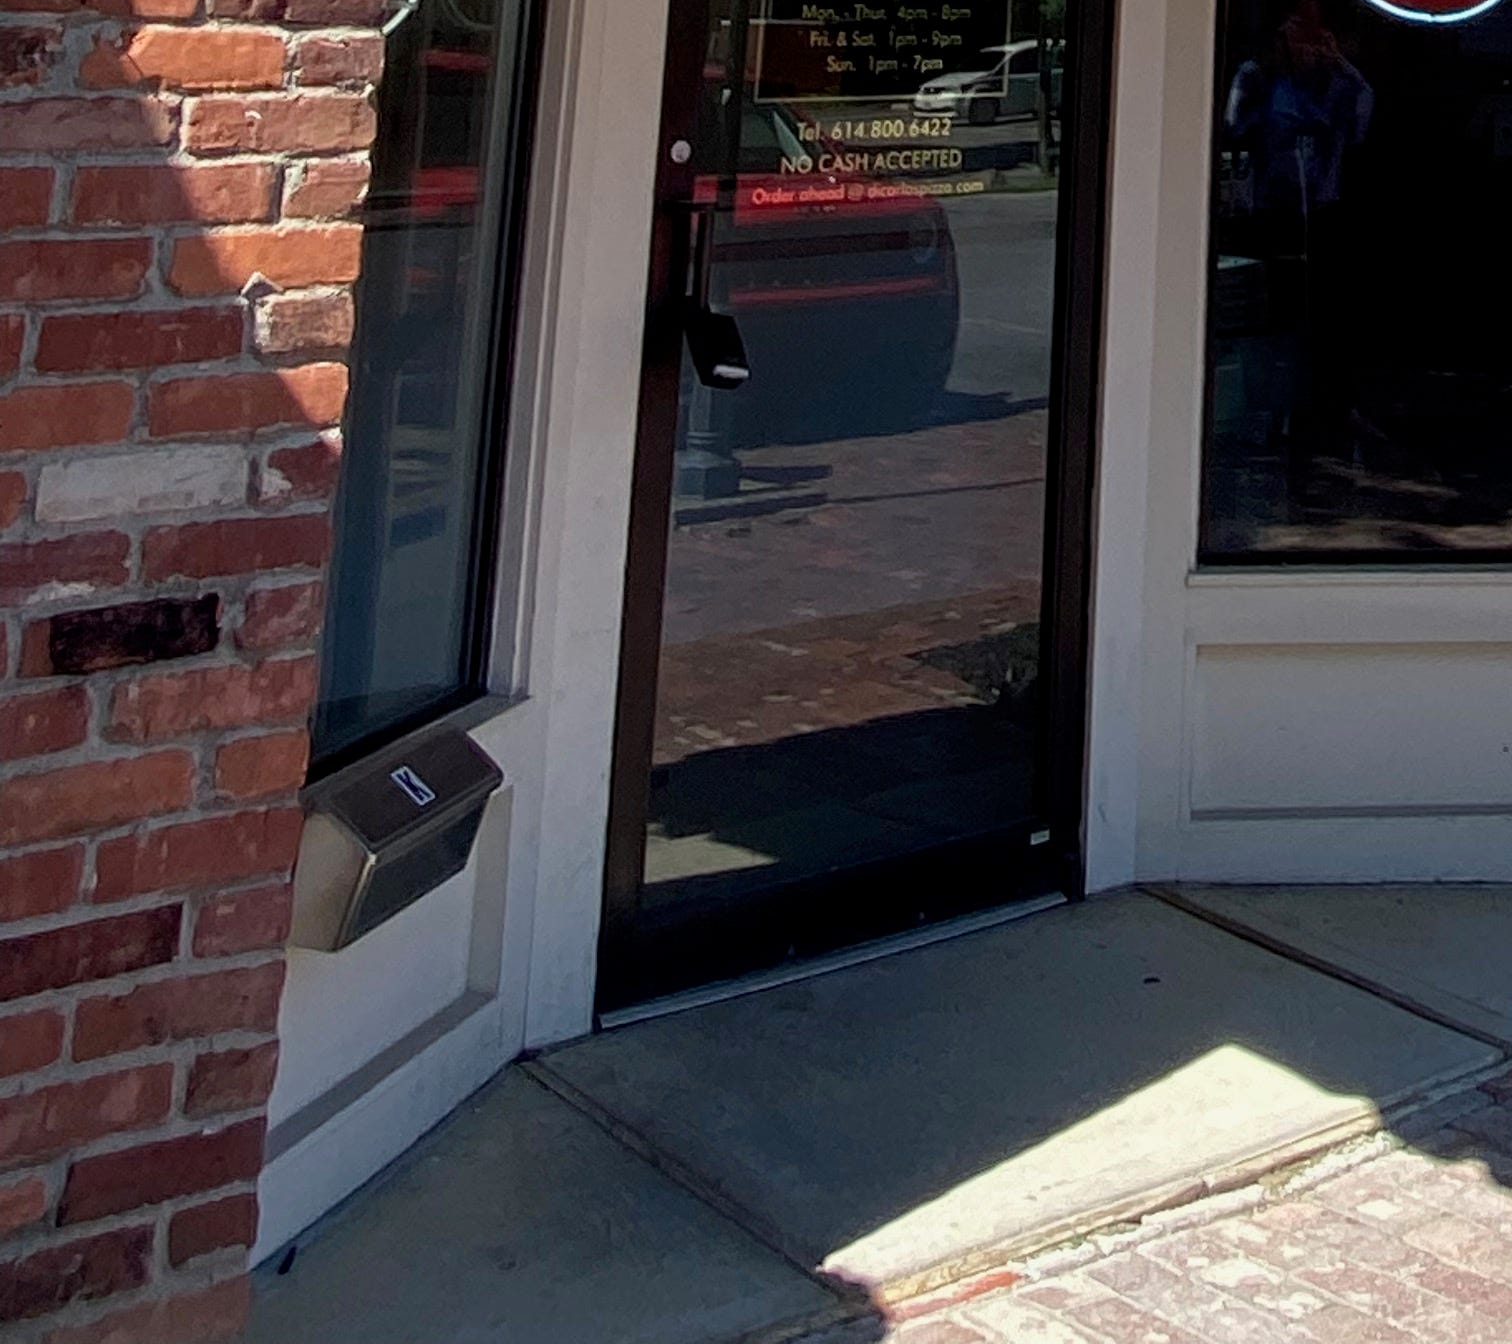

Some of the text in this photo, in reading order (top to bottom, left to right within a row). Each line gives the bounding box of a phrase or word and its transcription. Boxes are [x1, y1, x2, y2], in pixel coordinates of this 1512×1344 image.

[836, 30, 848, 47] &
[912, 55, 944, 73] 7pm
[831, 117, 952, 141] 614.800.6422
[779, 148, 964, 174] NO CASH ACCEPTED
[799, 184, 845, 202] ahead
